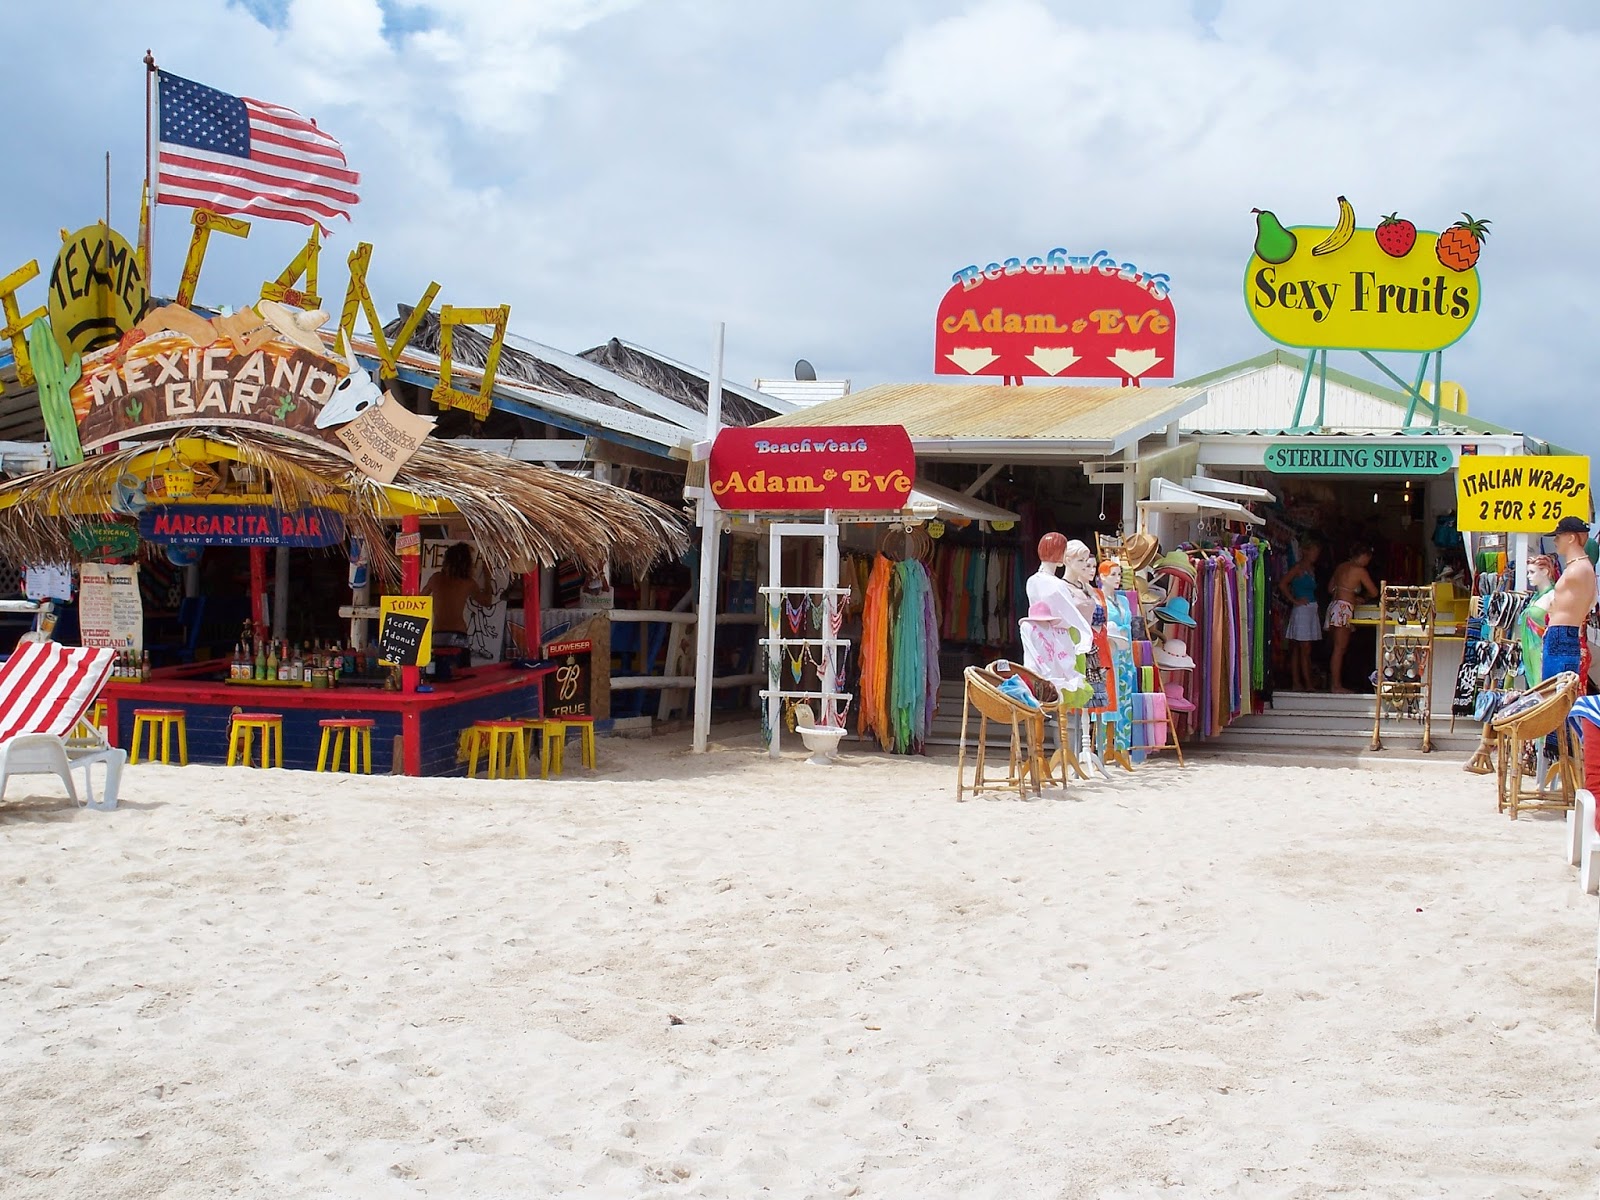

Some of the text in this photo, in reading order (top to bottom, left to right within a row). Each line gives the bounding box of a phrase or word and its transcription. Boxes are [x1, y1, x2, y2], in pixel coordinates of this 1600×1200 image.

[952, 247, 1171, 301] Beachwears
[1254, 266, 1470, 323] Sexy Fruits
[942, 307, 1171, 334] Adam & Eve
[89, 348, 337, 406] MEXICANO
[165, 380, 262, 416] BAR
[342, 428, 384, 472] BOUM BOUM
[1276, 449, 1439, 469] STERLING SILVER
[711, 468, 912, 496] Adam & Eve
[1462, 467, 1586, 499] ITALIAN WRAPS
[1479, 500, 1490, 521] 2
[1493, 500, 1522, 521] FOR
[1542, 500, 1562, 521] 25
[153, 513, 322, 537] MARGARITA BAR
[390, 600, 427, 611] TODAY
[549, 641, 591, 653] BUDWEISER
[552, 703, 586, 716] TRUE
